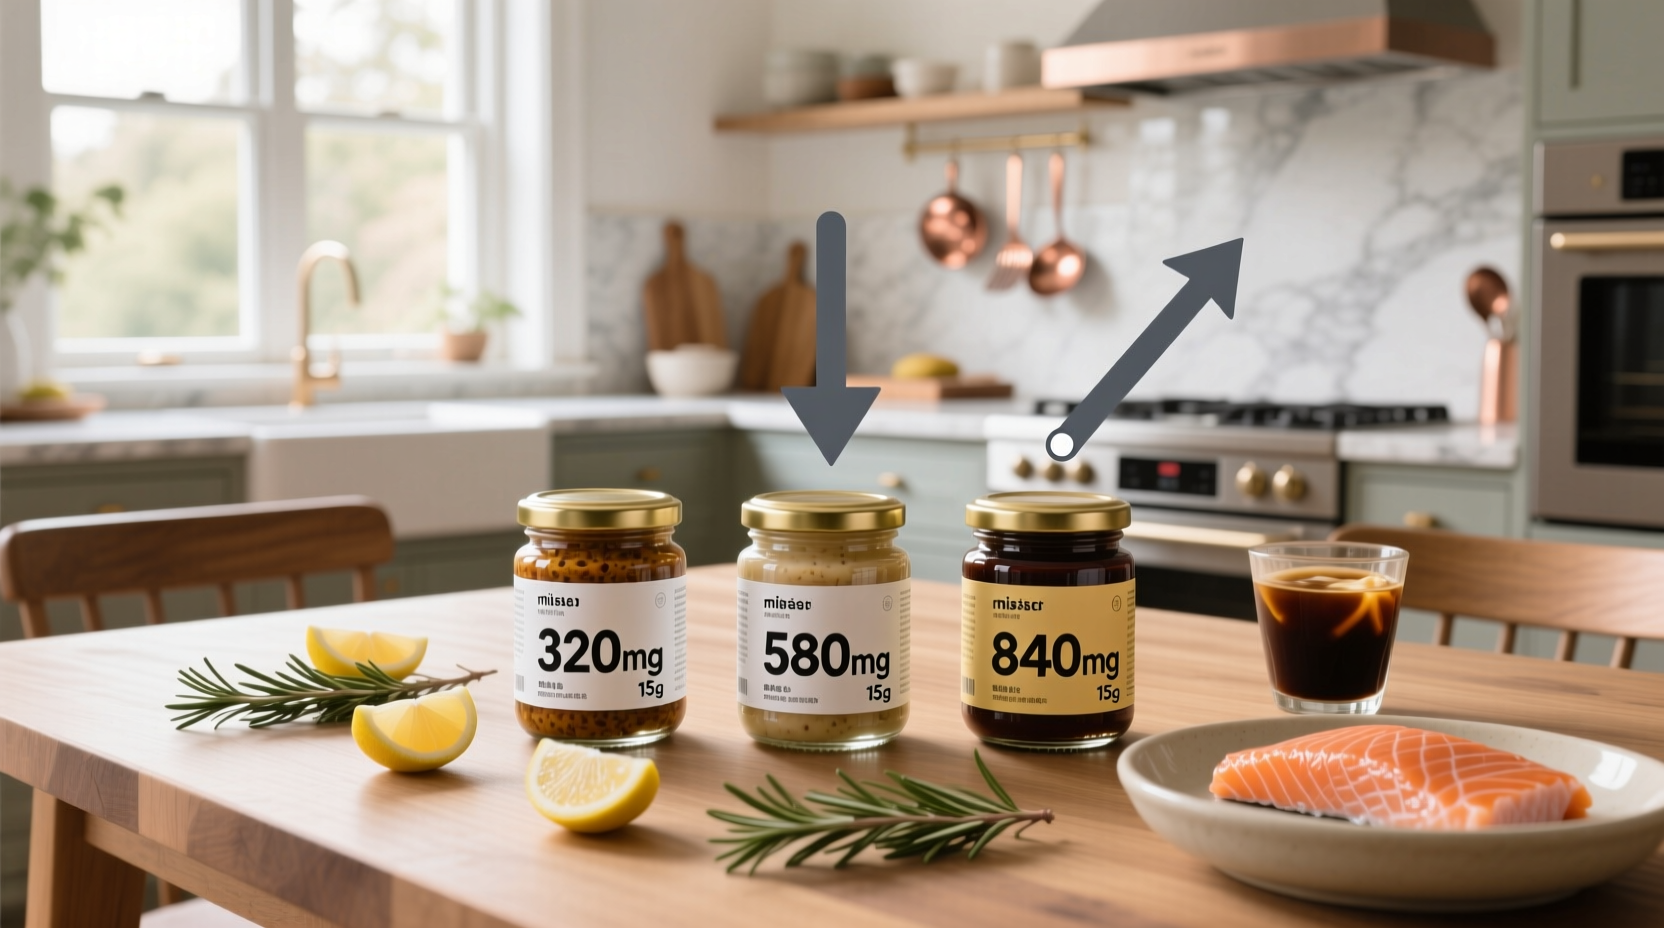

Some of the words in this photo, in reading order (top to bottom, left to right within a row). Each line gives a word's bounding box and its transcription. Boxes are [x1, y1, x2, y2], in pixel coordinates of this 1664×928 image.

[537, 627, 663, 676] 320mg
[763, 630, 890, 680] 580mg
[991, 631, 1119, 680] 840mg
[638, 680, 664, 699] 15g
[866, 684, 891, 703] 15g
[1096, 684, 1120, 703] 15g
